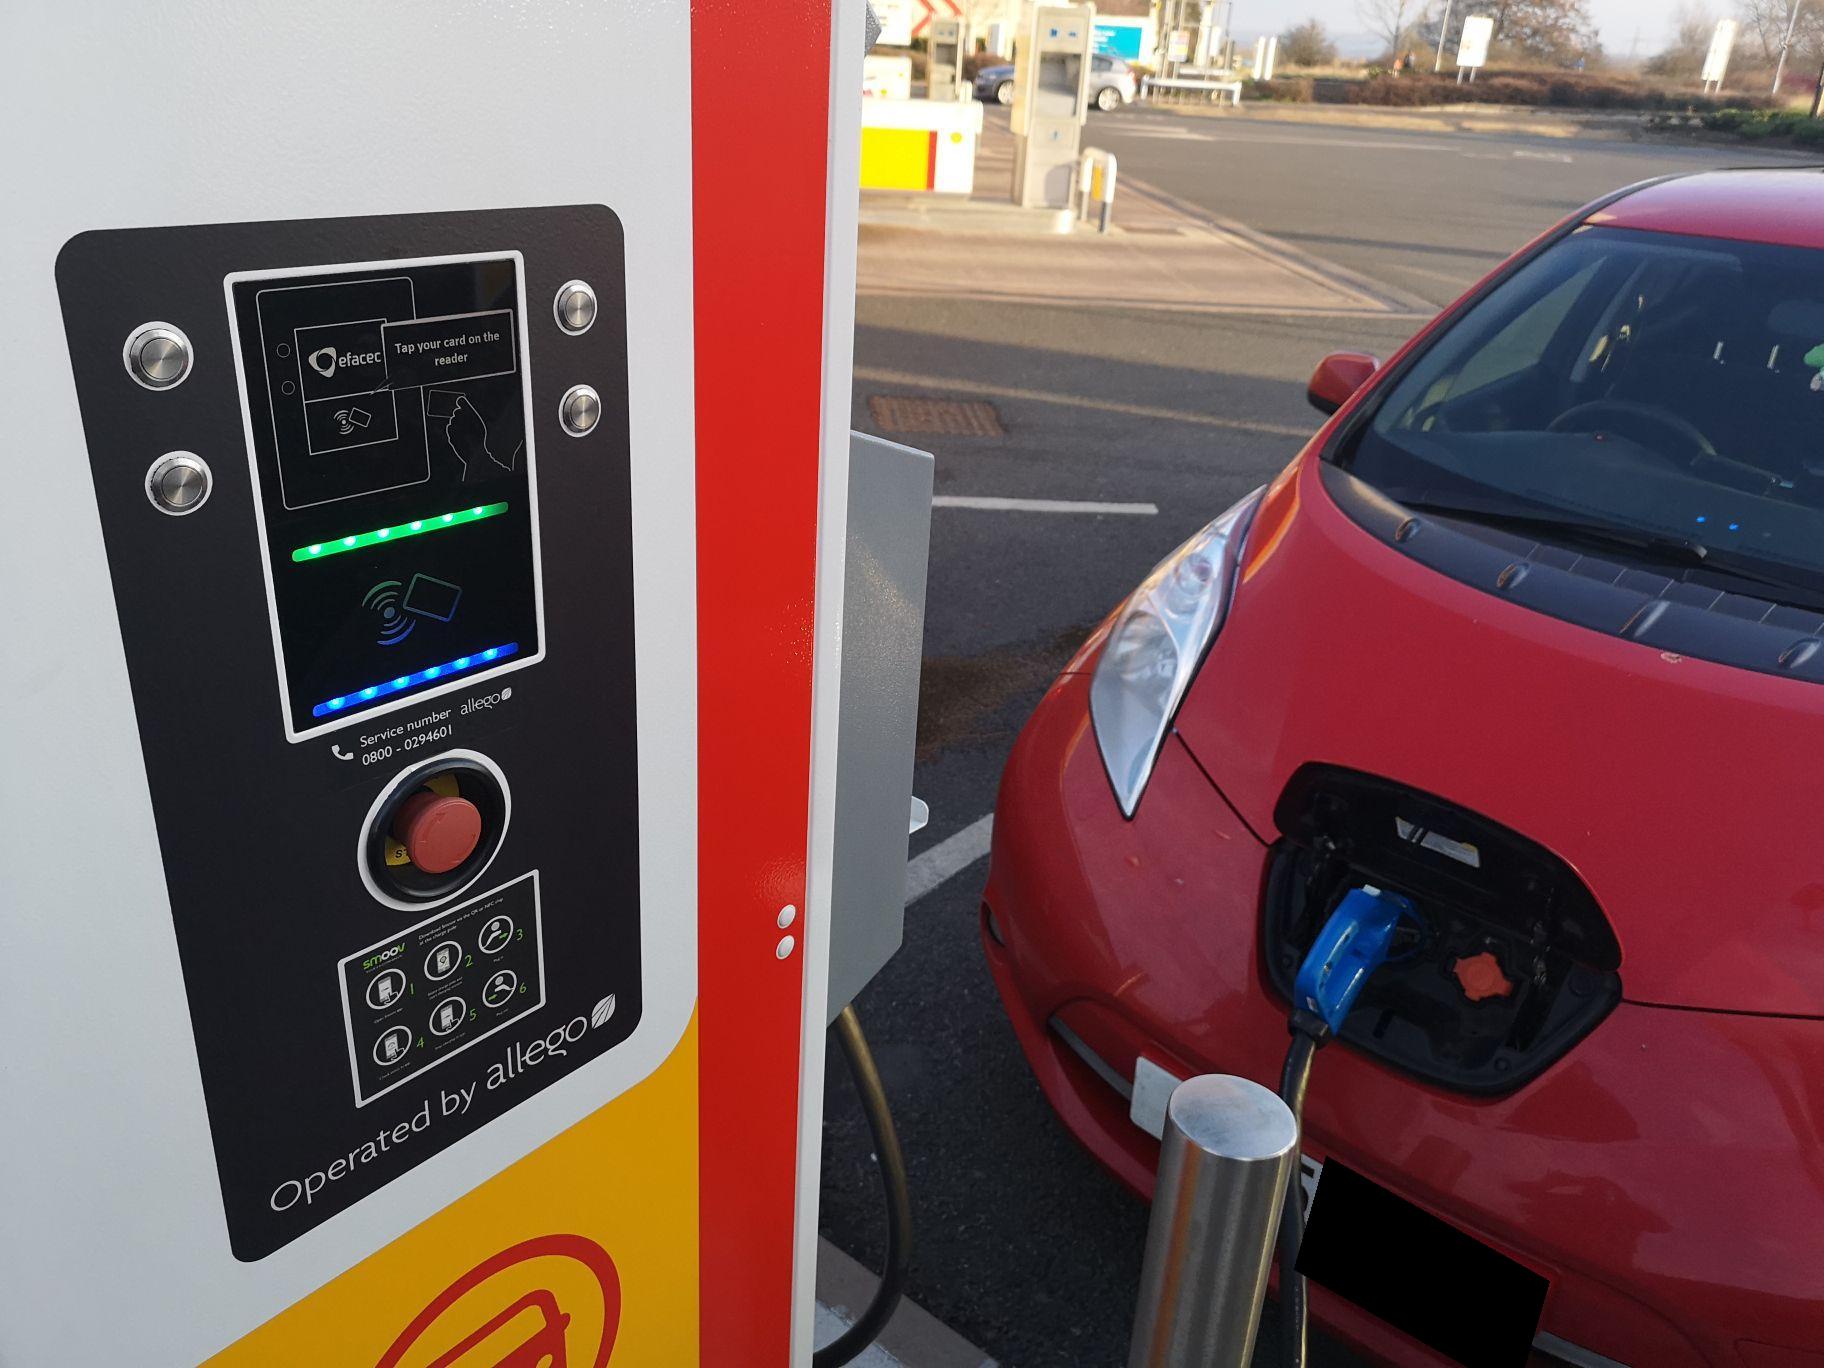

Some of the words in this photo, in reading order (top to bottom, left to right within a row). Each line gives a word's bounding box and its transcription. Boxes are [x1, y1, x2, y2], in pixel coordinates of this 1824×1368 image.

[394, 342, 415, 356] Tap
[417, 338, 442, 353] your
[442, 333, 467, 348] card
[467, 335, 482, 346] on
[482, 331, 500, 344] the
[338, 350, 382, 369] efacec
[434, 353, 469, 367] reader
[460, 692, 501, 715] allego
[359, 726, 404, 748] Service
[406, 709, 452, 732] number
[362, 746, 393, 766] 0800
[404, 724, 452, 751] 0294601
[516, 928, 525, 941] 3
[362, 942, 406, 970] smoov
[464, 954, 474, 968] 2
[409, 982, 415, 995] 1
[519, 981, 527, 994] 6
[469, 1008, 477, 1022] 5
[416, 1036, 425, 1048] 4
[269, 1099, 432, 1212] Operated
[440, 1081, 477, 1116] by
[486, 1015, 588, 1091] allego
